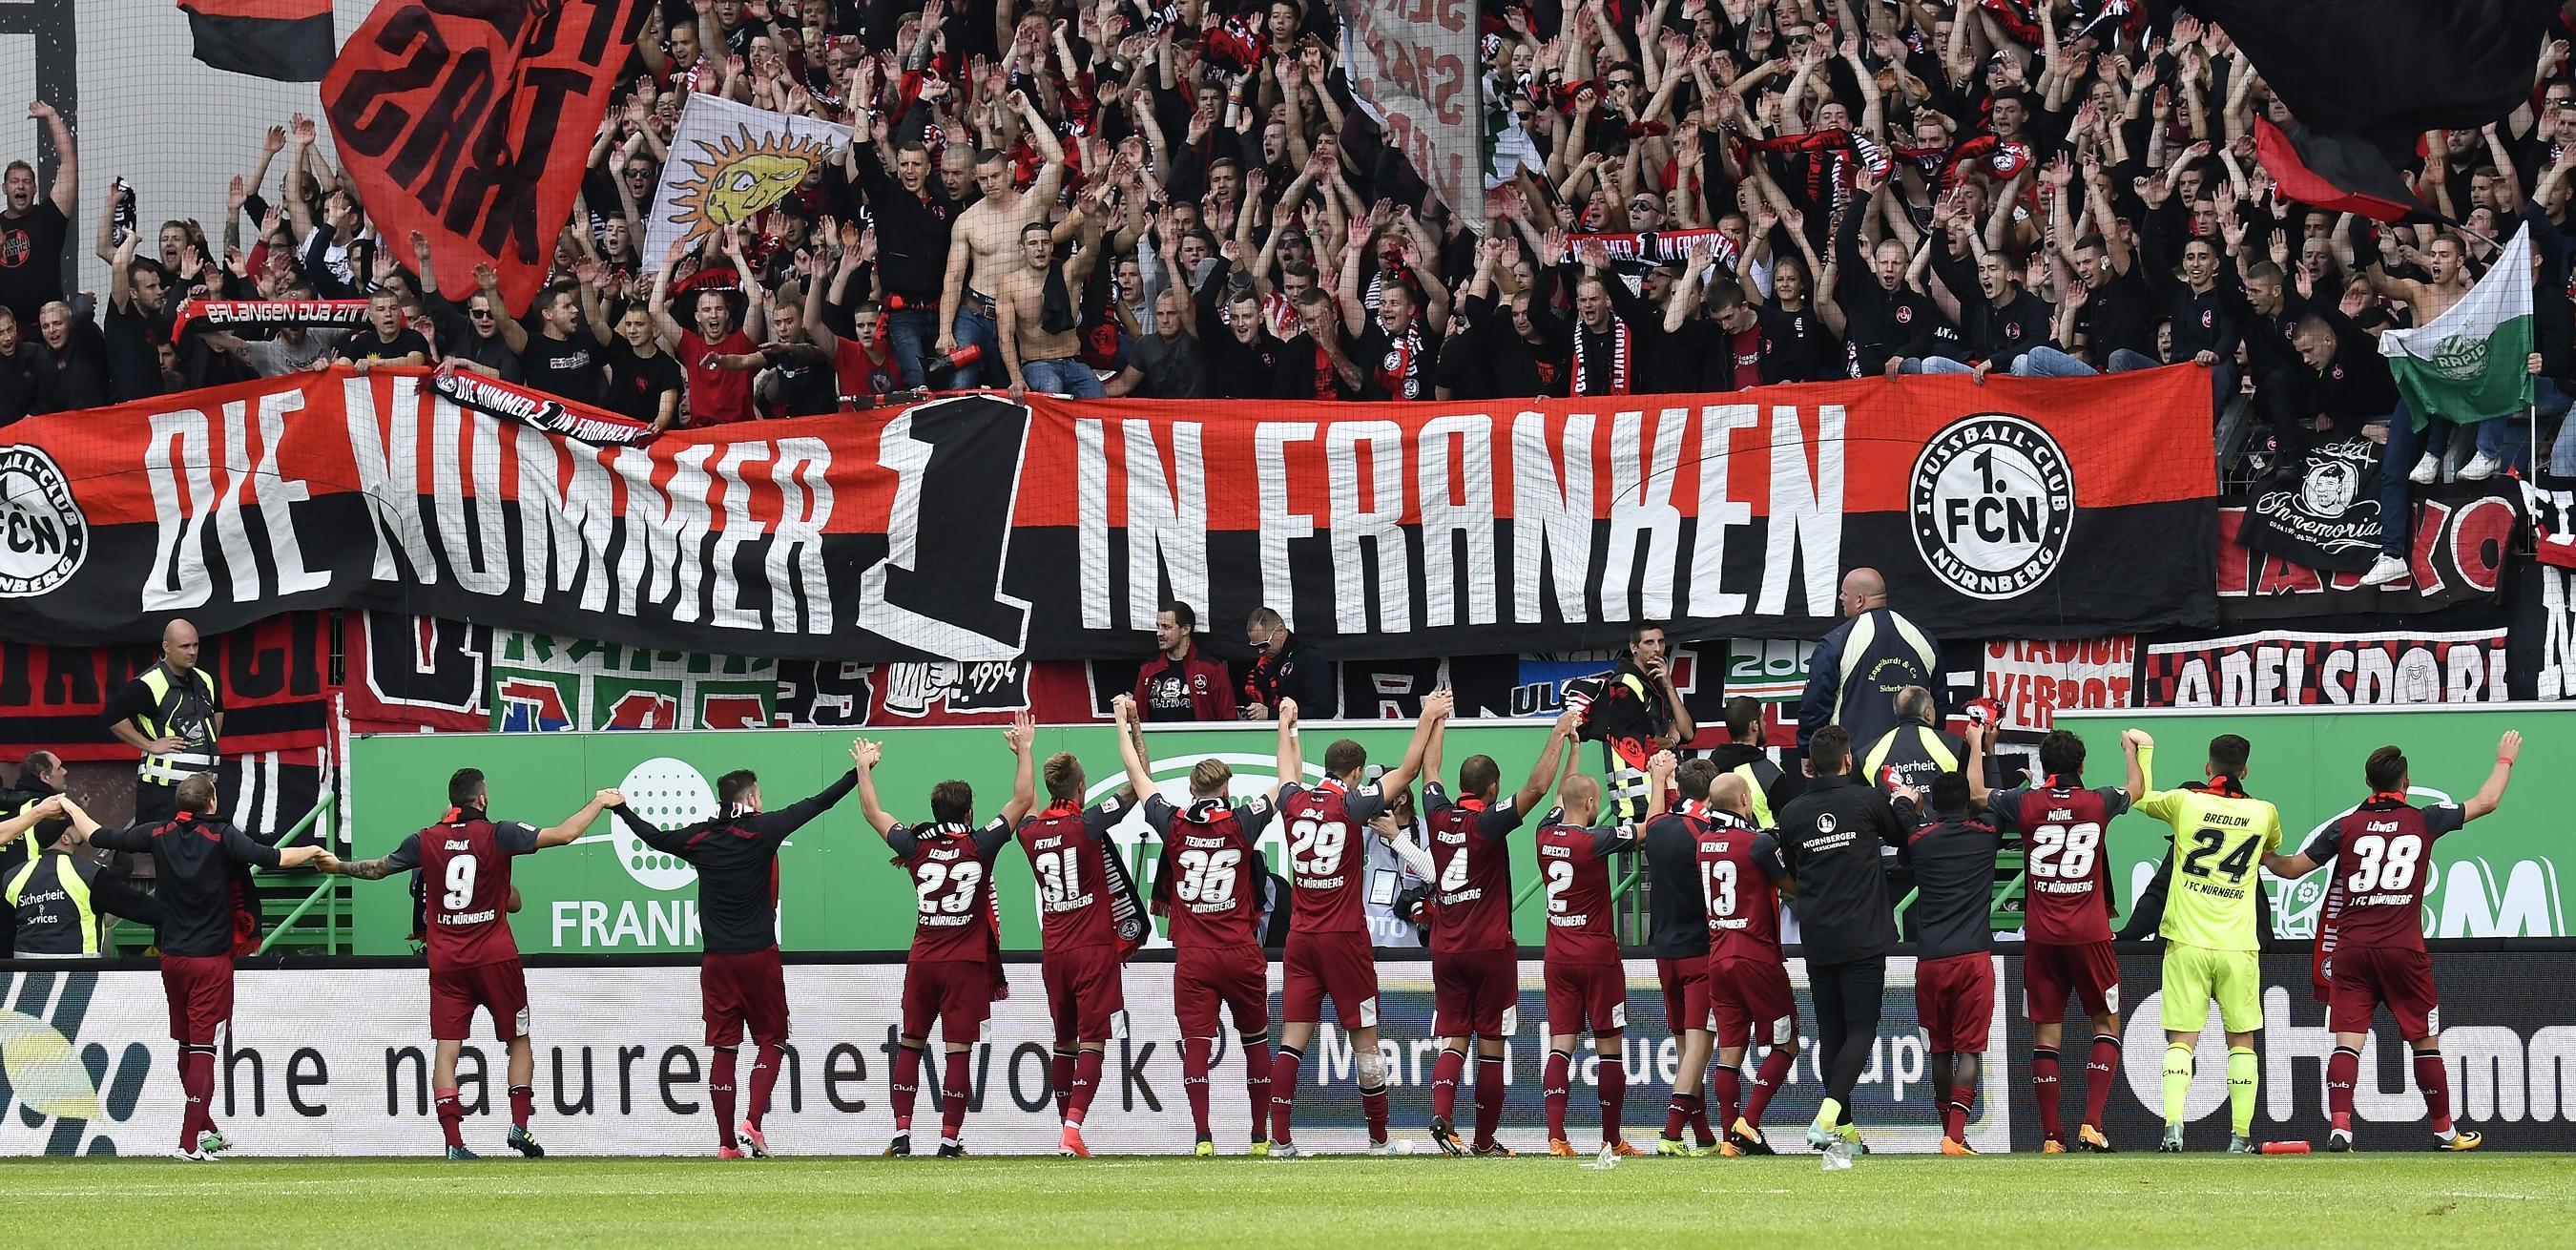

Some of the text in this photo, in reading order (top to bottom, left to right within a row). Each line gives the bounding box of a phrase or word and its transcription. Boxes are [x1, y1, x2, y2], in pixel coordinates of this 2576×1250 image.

[2437, 344, 2486, 367] RAPID
[454, 375, 476, 404] DIE
[476, 384, 536, 418] NUMMER
[529, 400, 565, 431] 1
[553, 411, 574, 433] IN
[1973, 447, 2007, 494] 1.
[142, 376, 1846, 663] DIE NUMMER 1 IN FRANKEN
[1945, 496, 2040, 544] FCN
[0, 512, 61, 554] CN
[1932, 546, 2054, 593] NÜRNBERG
[966, 664, 1016, 687] 1994
[1984, 671, 2132, 729] VERBOT
[1906, 774, 1914, 784] &
[2047, 808, 2072, 821] MÜHL
[2203, 812, 2250, 827] BREDLOW
[2366, 821, 2399, 832] LÖWEN
[445, 840, 470, 850] ISHAK
[1034, 835, 1062, 850] PETRAK
[1185, 836, 1225, 848] TEUCHERT
[1290, 820, 1346, 875] 29
[2030, 823, 2101, 879] 28
[2182, 827, 2263, 885] 24
[1441, 847, 1468, 892] 4
[2348, 834, 2422, 893] 38
[443, 854, 477, 910] 9
[1036, 846, 1080, 903] 31
[1176, 848, 1241, 904] 36
[1303, 875, 1344, 889] NÜRNBERG
[917, 861, 983, 913] 23
[1547, 861, 1573, 913] 2
[1700, 860, 1737, 917] 13
[2047, 879, 2094, 893] NÜRNBERG
[2200, 885, 2245, 900] NÜRNBERG
[18, 889, 65, 906] Sicherheit
[1191, 897, 1236, 914] NÜRNBERG
[2368, 893, 2413, 906] NÜRNBERG
[452, 909, 495, 925] NÜRNBERG
[2086, 1061, 2108, 1072] Club
[2162, 1068, 2189, 1077] Club
[222, 1045, 328, 1118] he
[386, 1043, 700, 1117] naure
[709, 1083, 732, 1092] Club
[1184, 1075, 1208, 1086] Club
[1246, 1076, 1271, 1086] Club
[1432, 1079, 1454, 1090] Club
[2033, 1075, 2057, 1084] Club
[2326, 1080, 2350, 1089] Club
[893, 1083, 917, 1093] Club
[942, 1089, 964, 1098] Club
[1543, 1087, 1565, 1097] Club
[1272, 1096, 1292, 1105] Club
